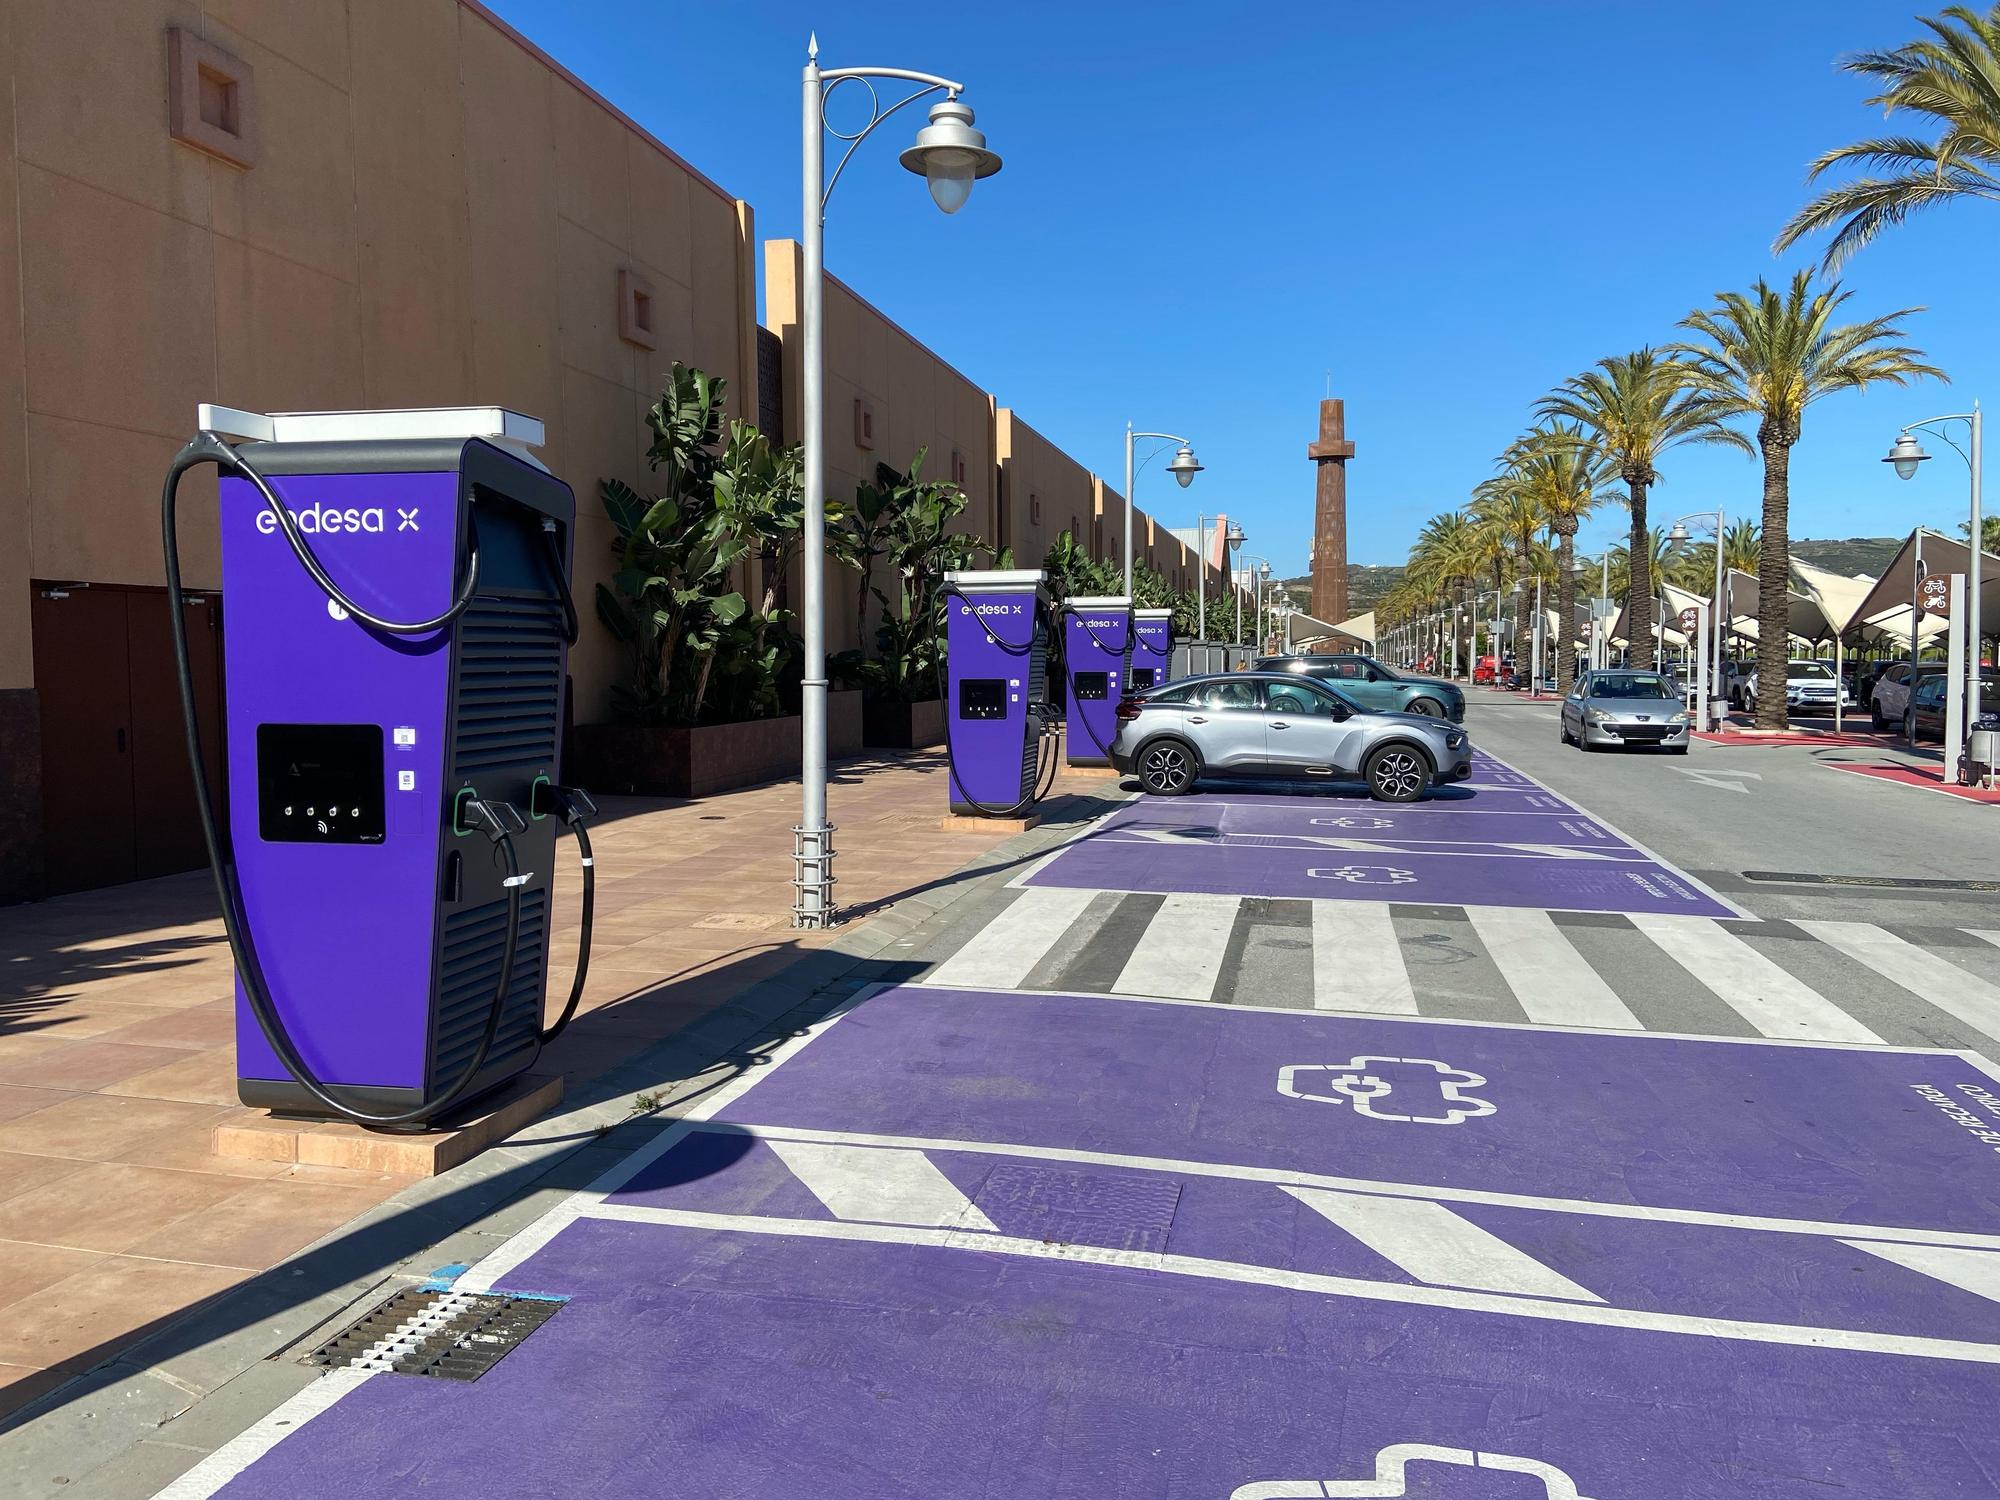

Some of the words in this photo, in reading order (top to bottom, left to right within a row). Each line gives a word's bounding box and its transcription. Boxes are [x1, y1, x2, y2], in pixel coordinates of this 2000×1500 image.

[961, 603, 1009, 615] edesa
[1076, 619, 1110, 628] edesa
[1908, 1084, 1990, 1129] RECARGA
